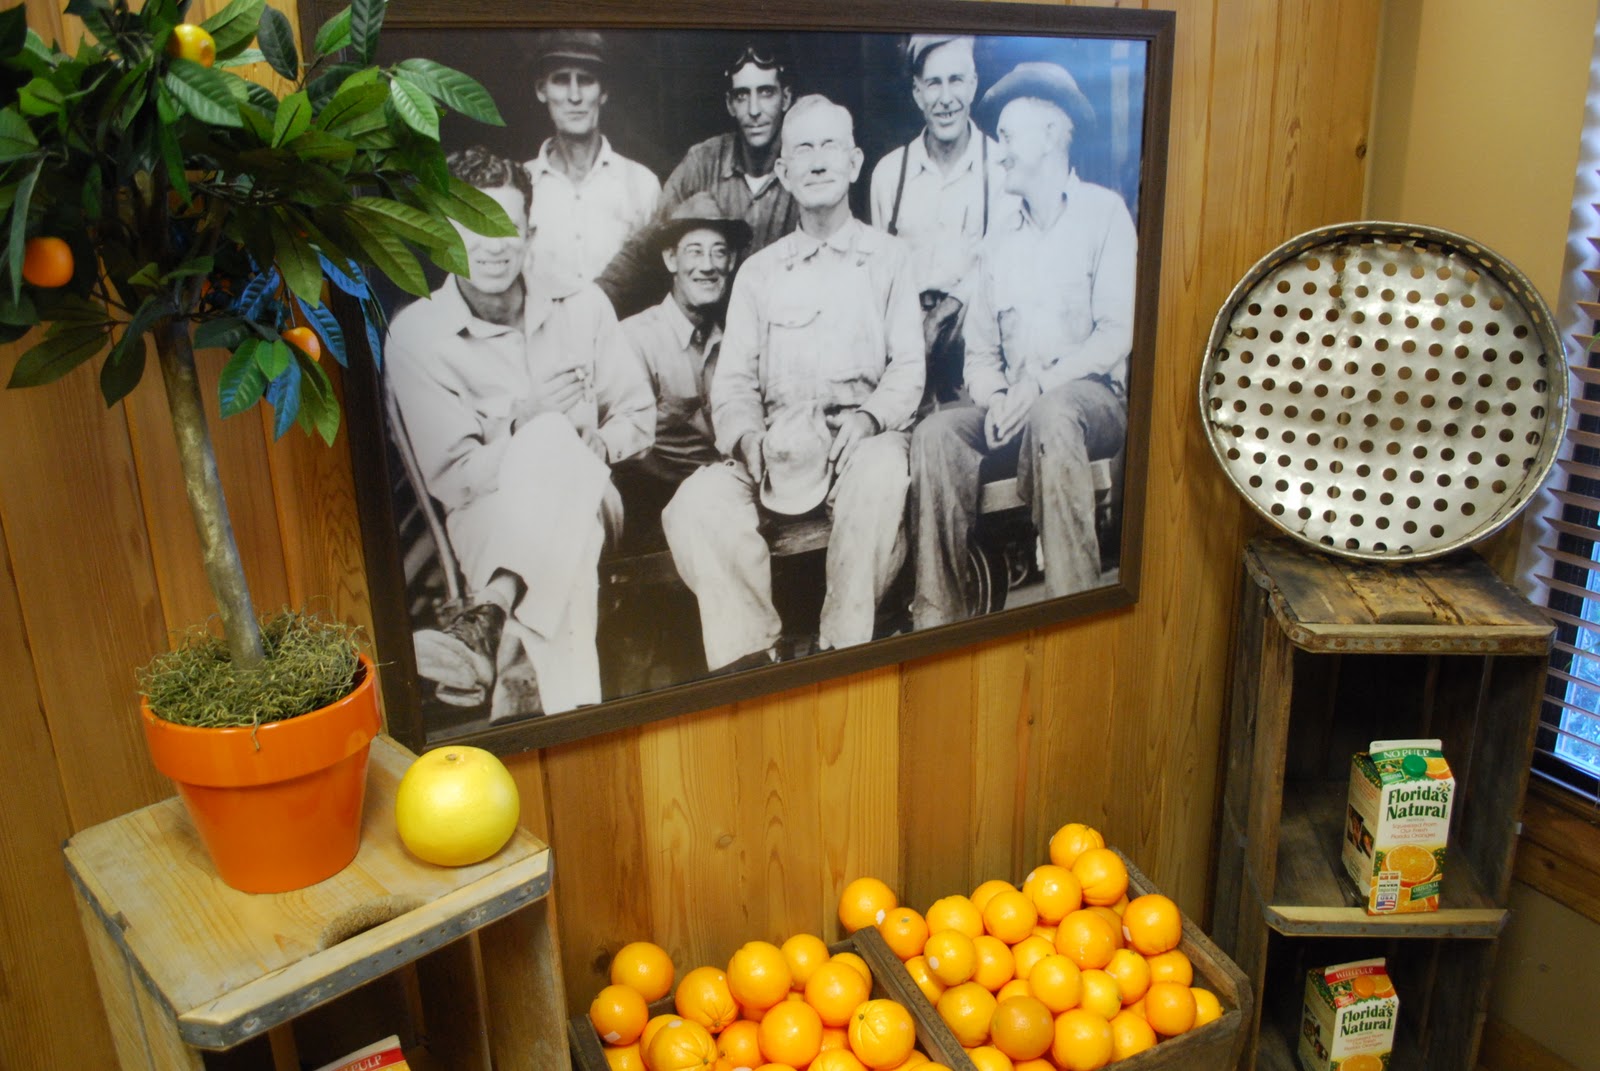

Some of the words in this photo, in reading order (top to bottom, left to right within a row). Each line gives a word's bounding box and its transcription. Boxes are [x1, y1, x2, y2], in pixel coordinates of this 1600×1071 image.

[1383, 750, 1400, 759] NO
[1386, 803, 1446, 821] Natural
[1340, 1018, 1391, 1037] Natural
[352, 1055, 381, 1071] PULP
